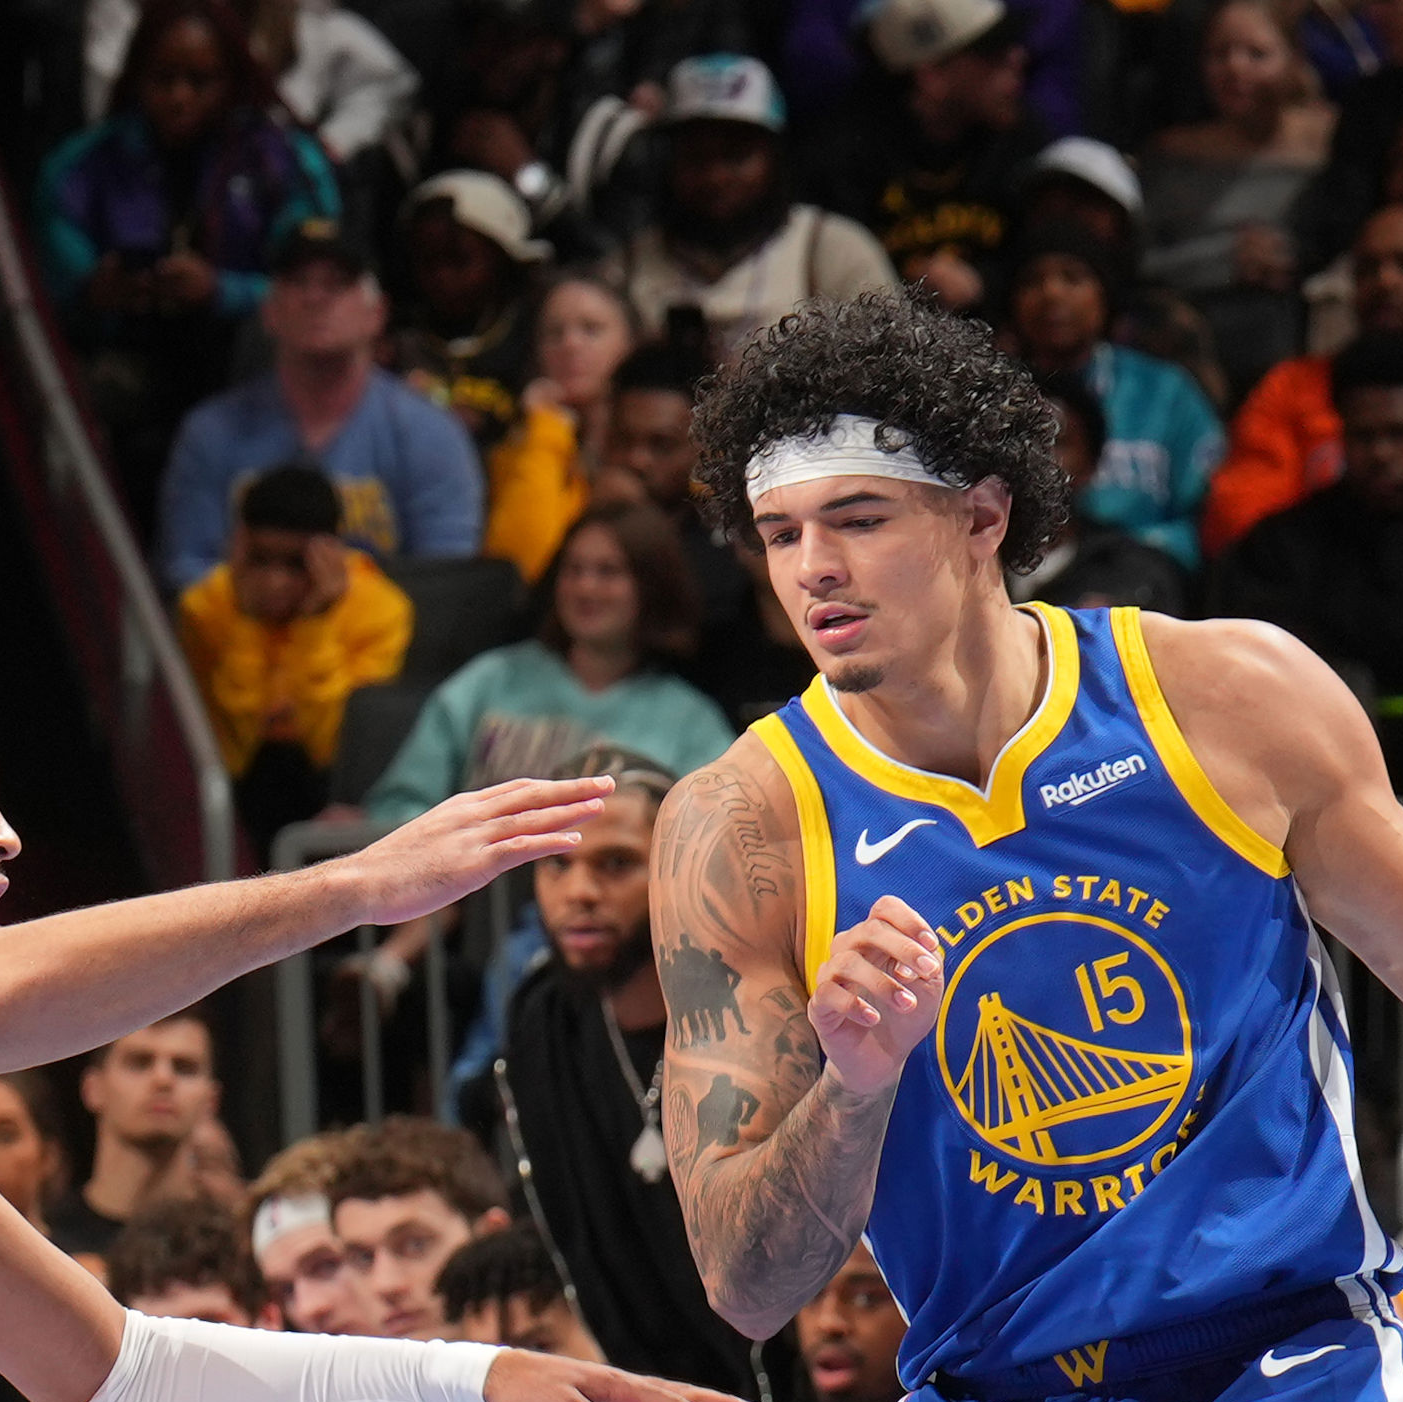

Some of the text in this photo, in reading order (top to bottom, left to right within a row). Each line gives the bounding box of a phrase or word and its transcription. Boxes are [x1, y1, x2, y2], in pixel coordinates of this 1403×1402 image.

[1040, 753, 1147, 809] Rakuten
[936, 874, 1171, 948] LDEN STATE
[1074, 951, 1146, 1033] 15
[969, 1108, 1199, 1216] WARRIO
[1053, 1340, 1110, 1387] W
